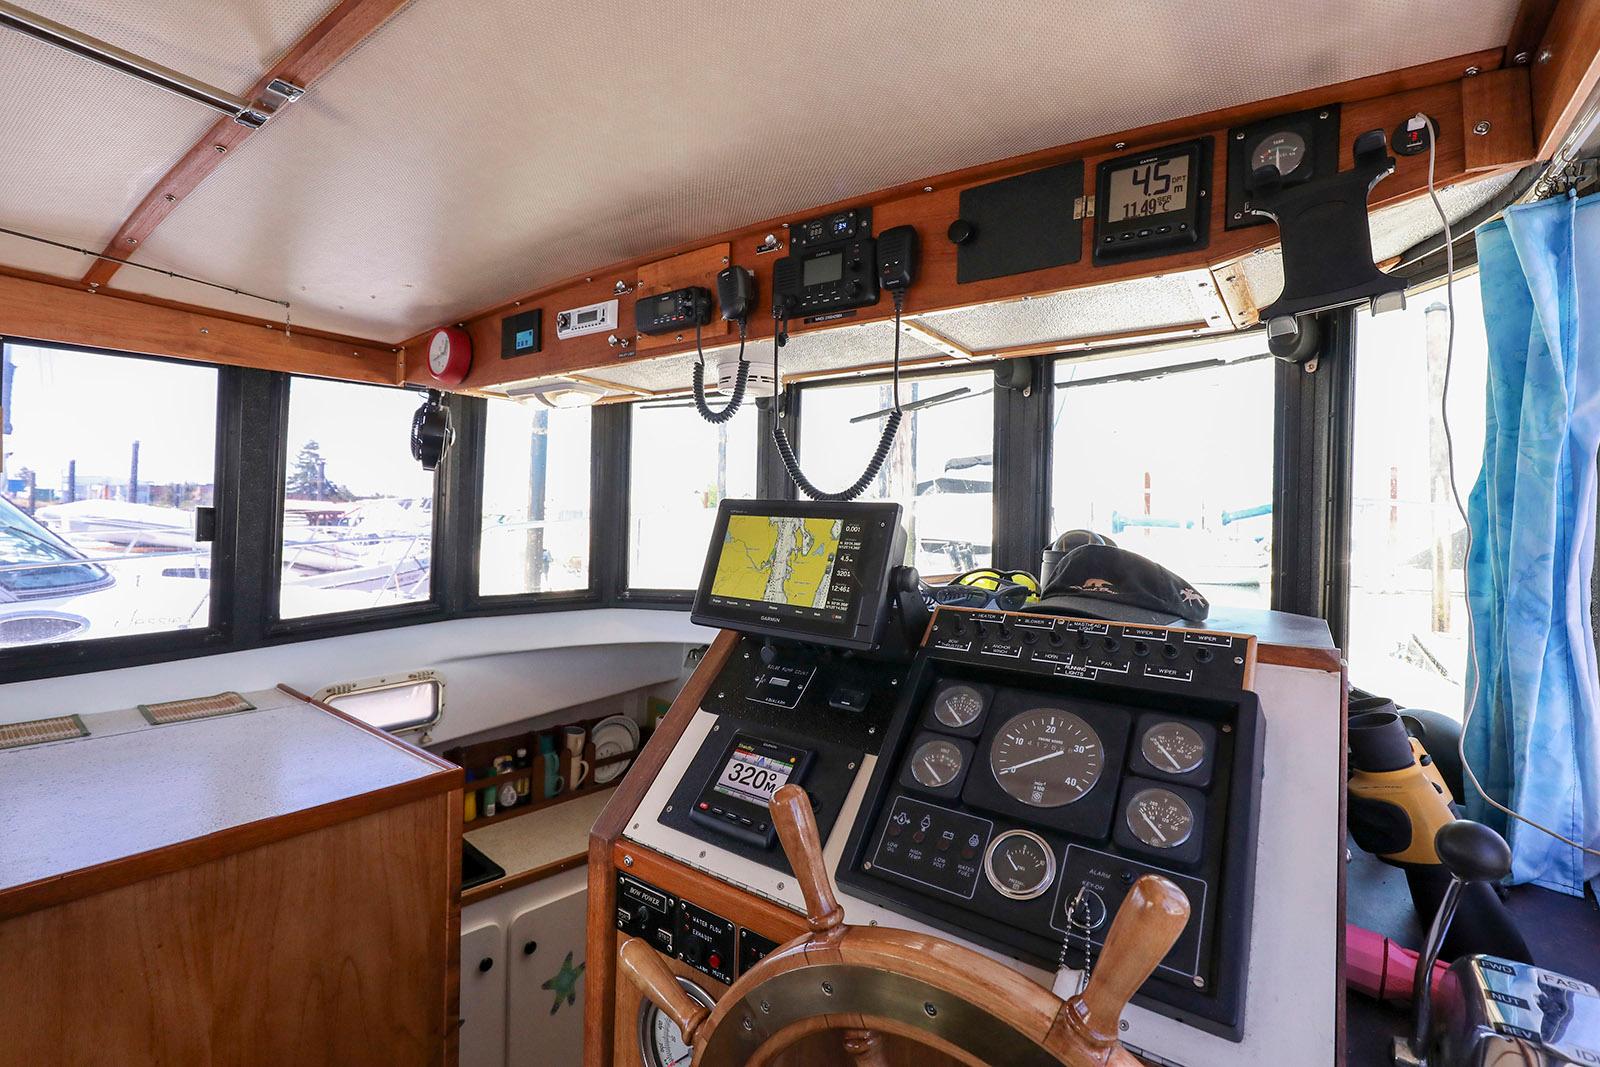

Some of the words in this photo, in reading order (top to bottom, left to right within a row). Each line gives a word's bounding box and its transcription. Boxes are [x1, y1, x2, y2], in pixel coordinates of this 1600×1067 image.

[1174, 185, 1183, 193] m
[760, 615, 780, 623] GARMIN
[1159, 668, 1177, 676] WIPER
[1046, 725, 1056, 734] 20
[1015, 737, 1024, 746] 10
[1073, 744, 1085, 754] 30
[1065, 776, 1077, 787] 40
[763, 782, 776, 793] M
[957, 864, 975, 873] WATER
[1089, 868, 1111, 879] ALARM
[629, 886, 642, 897] BOW
[641, 892, 660, 906] POWER
[692, 916, 708, 928] WATER
[709, 924, 722, 934] FLOW
[692, 928, 713, 943] EXHAUST
[1481, 960, 1513, 974] FWD
[1543, 974, 1590, 993] FAST
[1491, 991, 1521, 1006] NUT
[1503, 1024, 1532, 1039] REV
